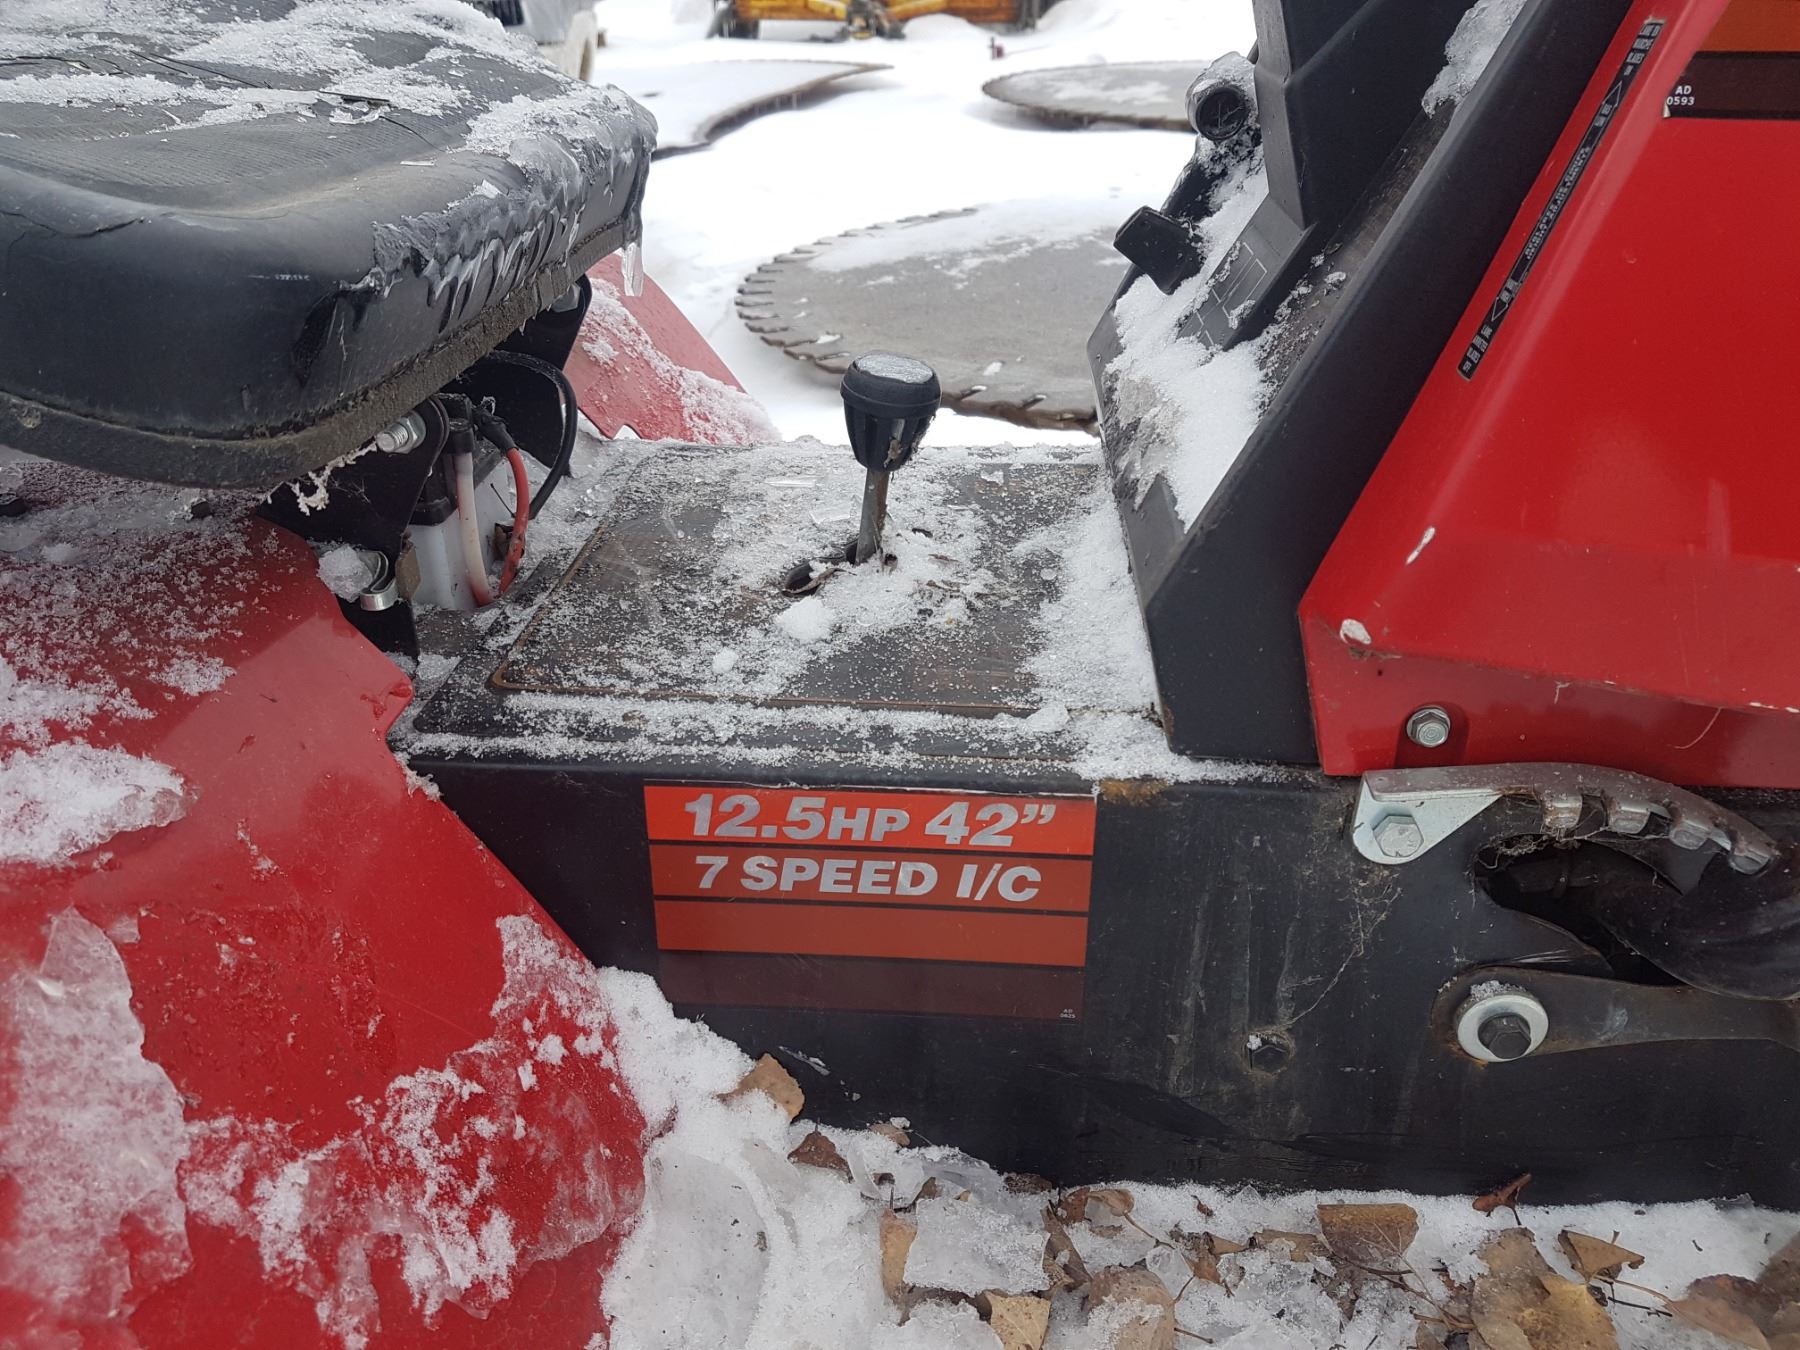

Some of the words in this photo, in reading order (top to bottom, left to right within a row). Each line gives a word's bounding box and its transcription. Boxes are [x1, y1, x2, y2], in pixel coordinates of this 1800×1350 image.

[1666, 96, 1695, 106] 0593
[1675, 85, 1692, 95] AD
[684, 793, 910, 842] 12.5HP
[695, 855, 728, 889] 7
[740, 855, 938, 896] SPEED
[956, 862, 1042, 901] I/C
